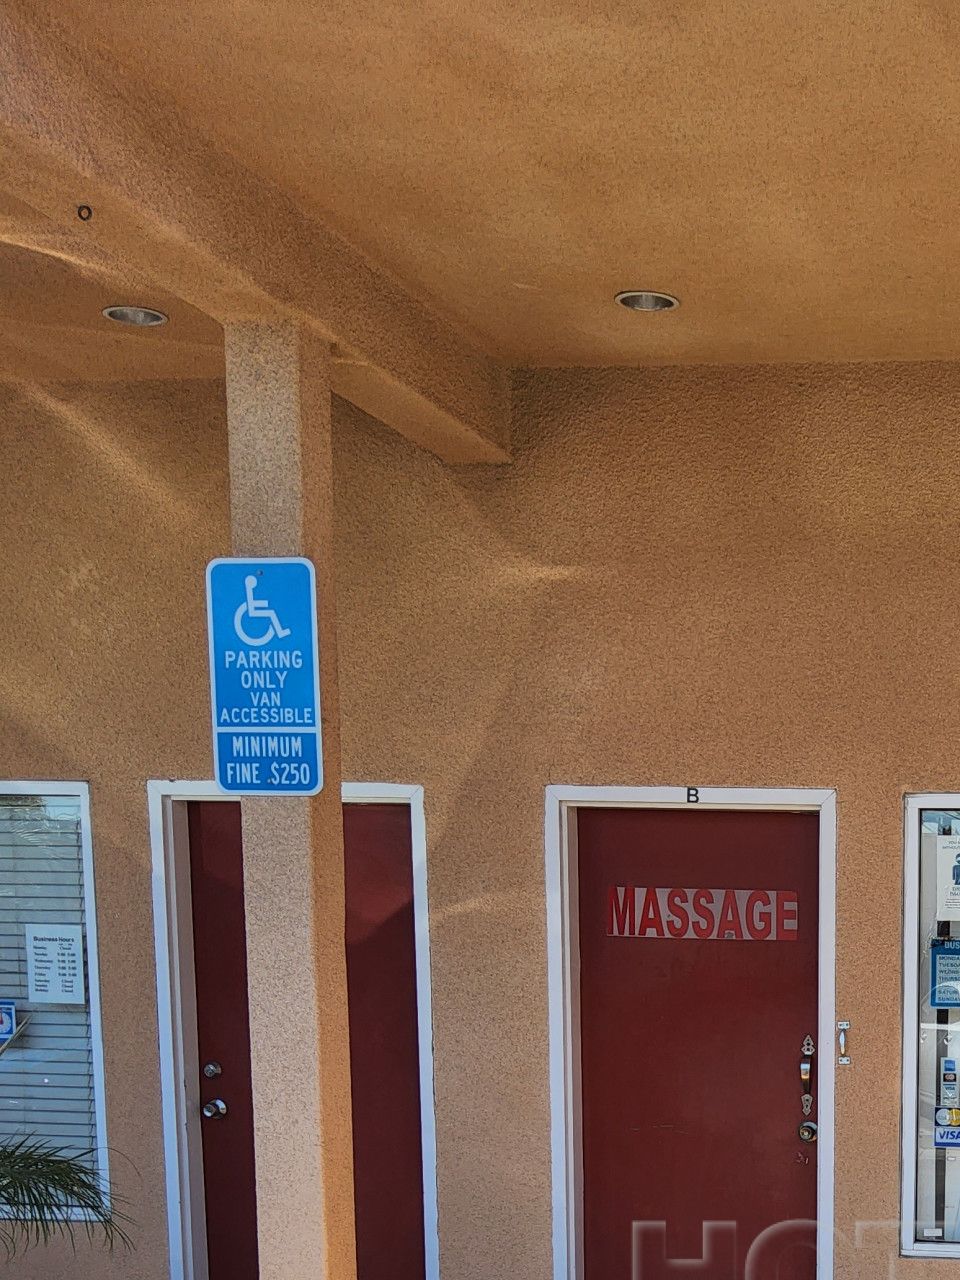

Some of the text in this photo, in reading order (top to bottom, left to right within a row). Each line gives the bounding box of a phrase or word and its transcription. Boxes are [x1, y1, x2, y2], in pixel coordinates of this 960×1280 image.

[225, 651, 303, 669] PARKING
[241, 671, 288, 689] ONLY
[250, 692, 281, 707] VAN
[220, 708, 313, 723] ACCESSIBLE
[232, 736, 303, 758] MINIMUM
[227, 761, 311, 786] FINE $250
[687, 788, 700, 804] B
[607, 885, 800, 941] MASSAGE
